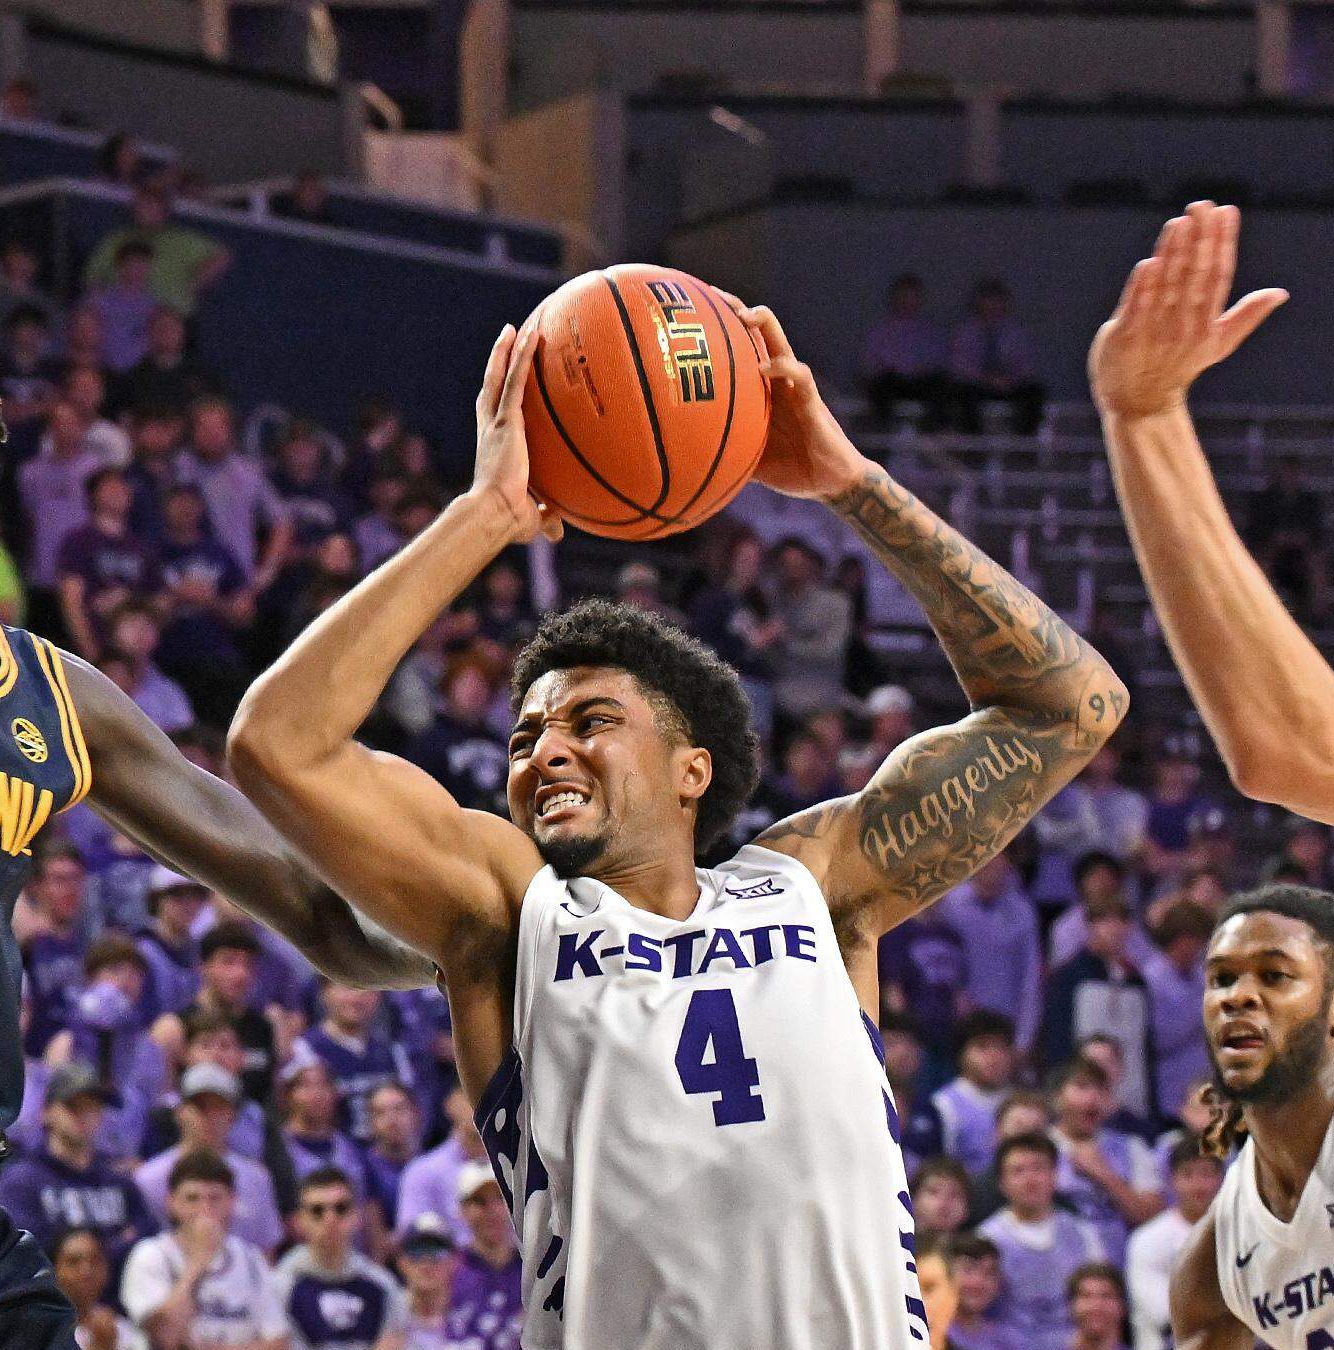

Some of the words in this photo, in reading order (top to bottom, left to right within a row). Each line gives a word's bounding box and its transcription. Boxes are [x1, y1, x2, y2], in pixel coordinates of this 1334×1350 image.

[863, 734, 1043, 870] Haggerty
[553, 924, 817, 982] K-STATE
[674, 988, 766, 1127] 4
